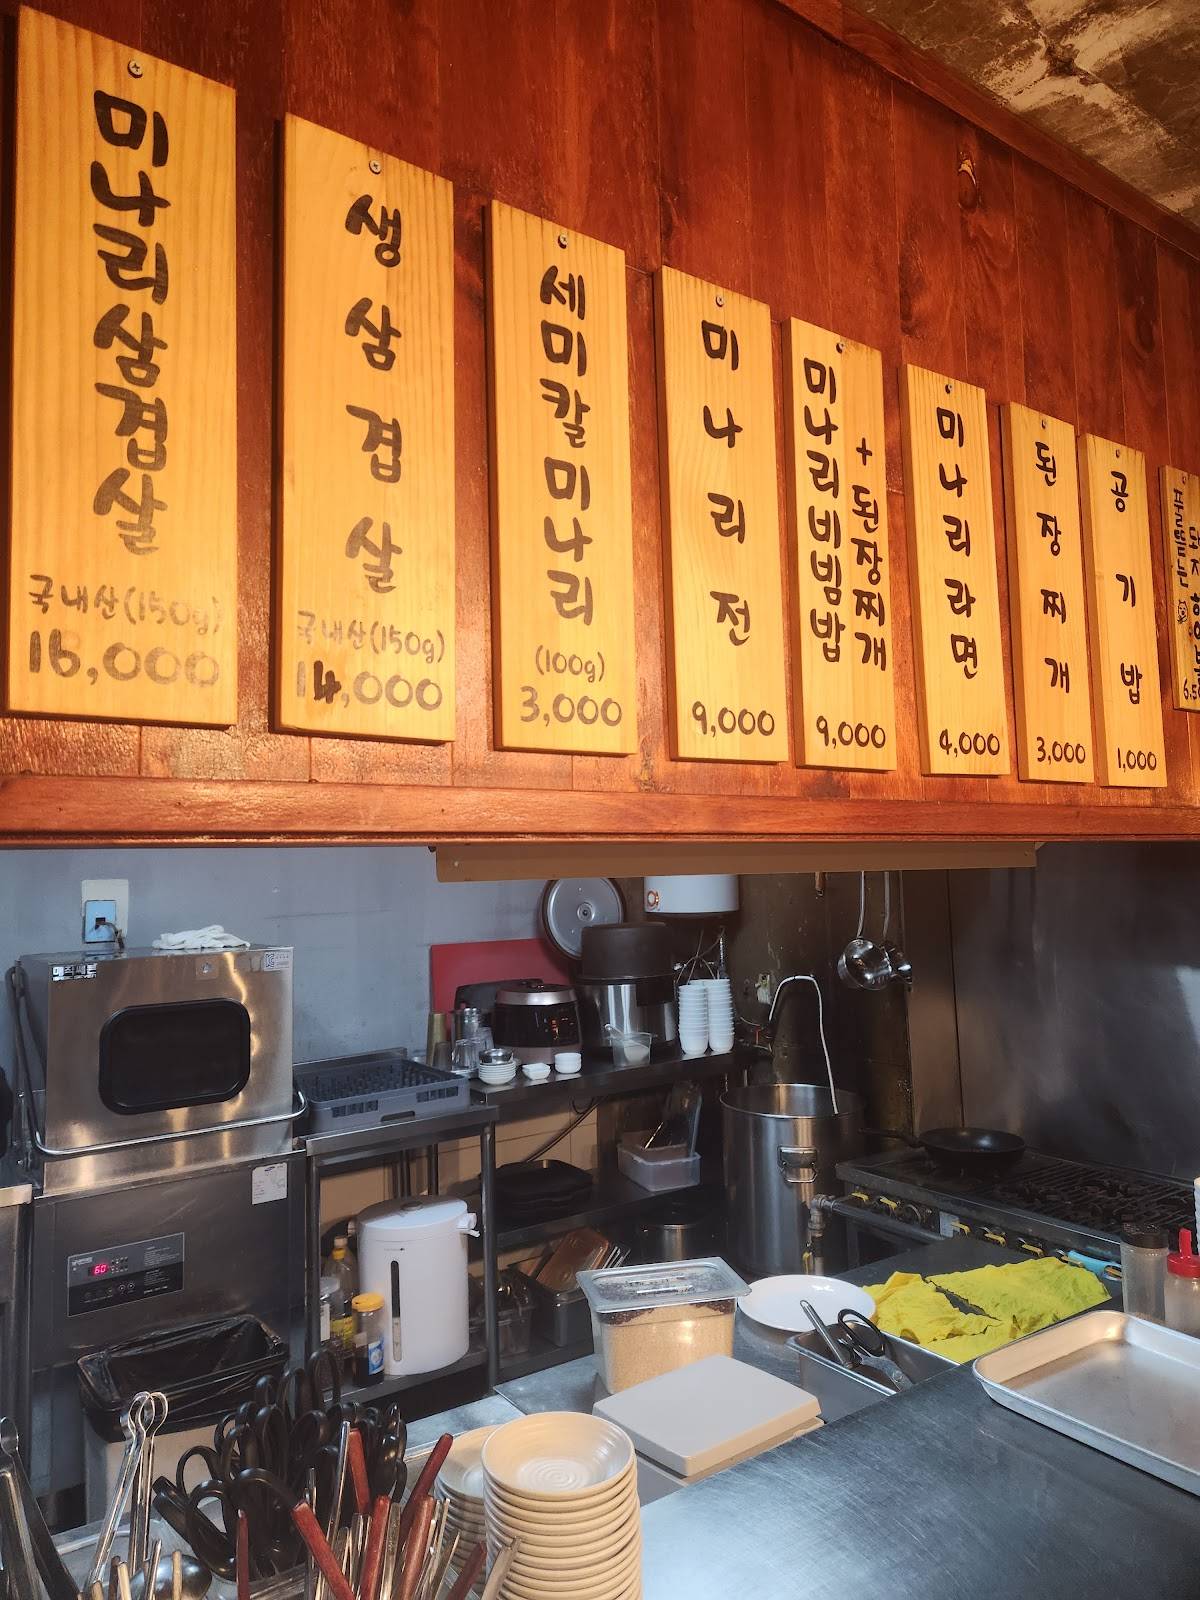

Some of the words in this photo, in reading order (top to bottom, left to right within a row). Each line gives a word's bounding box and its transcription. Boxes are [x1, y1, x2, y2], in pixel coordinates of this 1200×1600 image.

[90, 89, 172, 556] 미나리삼겹살
[701, 319, 751, 647] 미나리전
[803, 357, 846, 663] 미나리비빔밥
[936, 406, 977, 680] 미나리라면
[1034, 441, 1070, 694] 된장찌개
[1110, 470, 1143, 705] 공기밥
[29, 628, 220, 688] 16,000
[535, 645, 605, 683] (100g)
[296, 659, 443, 711] 14,000
[519, 685, 623, 727] 3,000
[691, 700, 775, 738] 9,000
[815, 715, 886, 749] 9,000
[939, 728, 1001, 757] 4,000
[1036, 736, 1086, 765] 3,000
[1117, 747, 1157, 773] 1,000
[93, 1263, 107, 1275] 60
